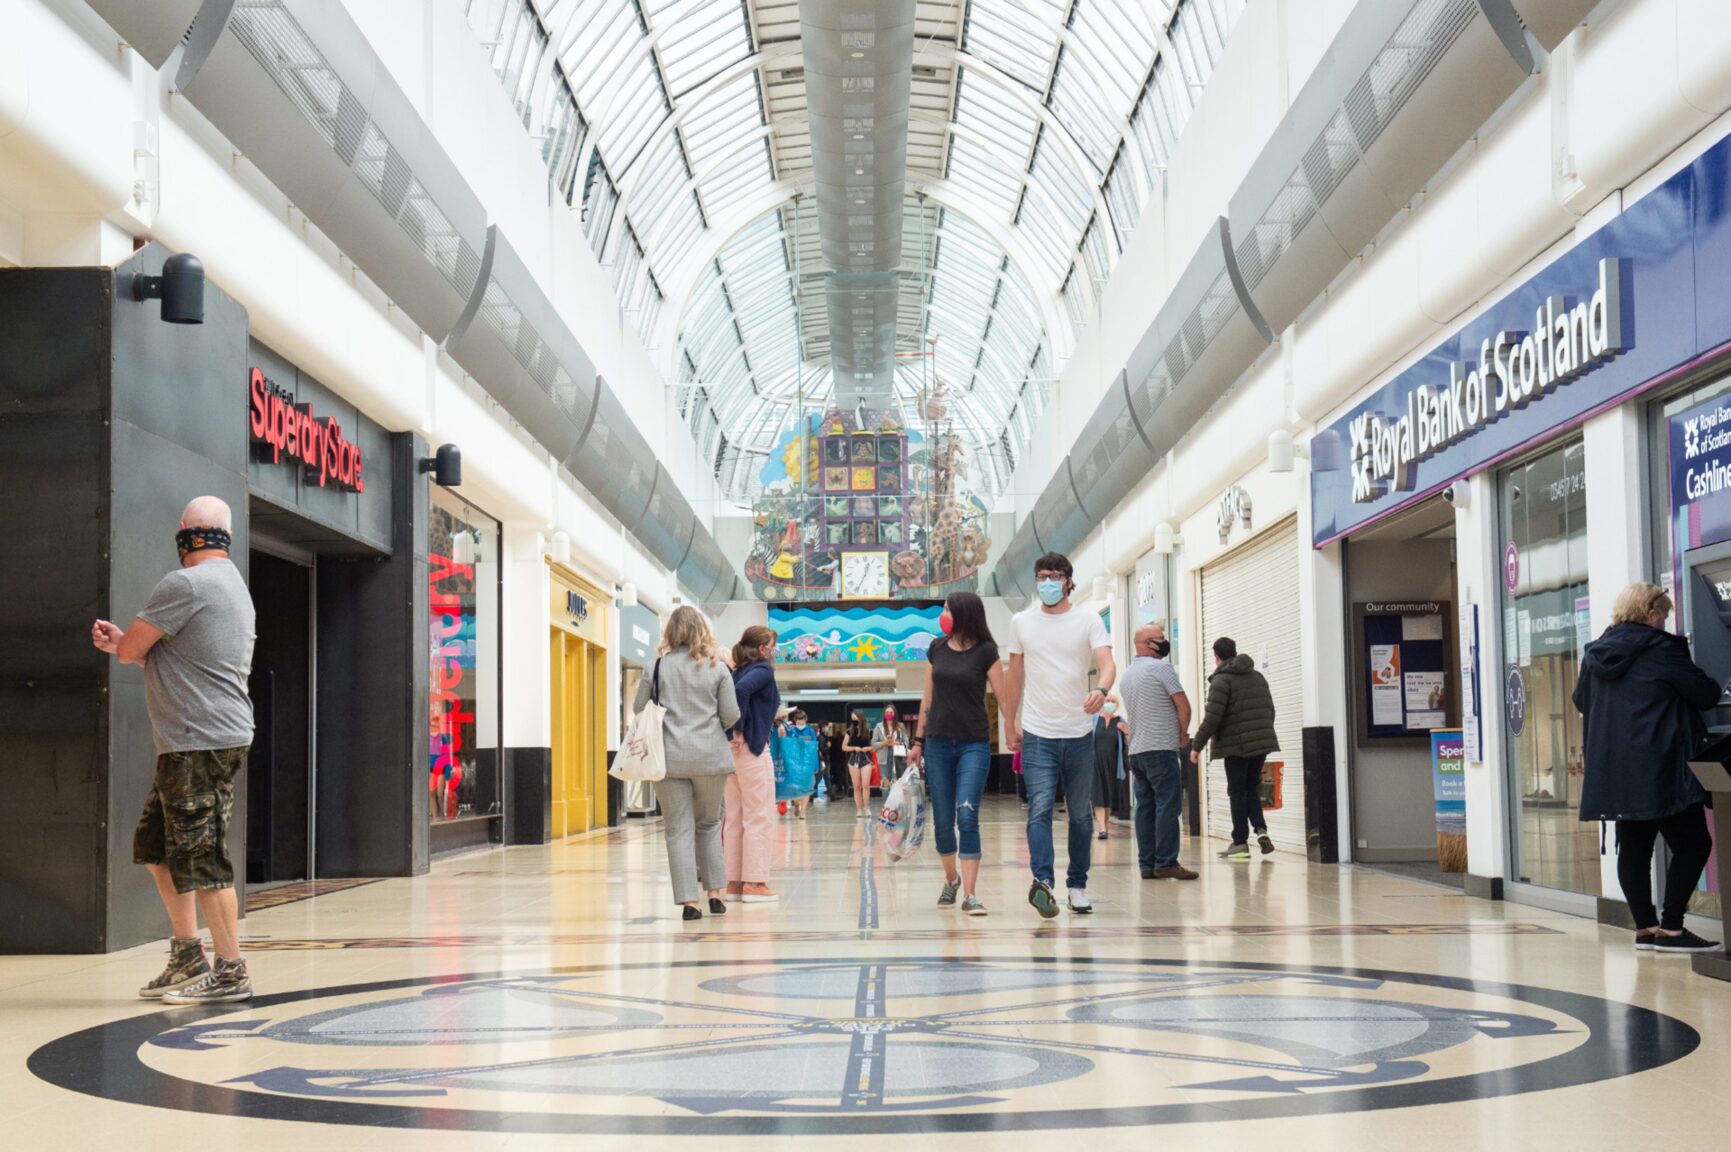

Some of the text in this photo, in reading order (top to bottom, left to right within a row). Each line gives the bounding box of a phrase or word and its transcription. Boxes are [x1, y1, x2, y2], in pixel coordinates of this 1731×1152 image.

[1372, 258, 1611, 492] Royal Bank of Scotland
[1701, 406, 1731, 433] Royal Ban
[1701, 429, 1731, 454] of Scotlan
[1686, 459, 1731, 500] Cashline
[1366, 602, 1440, 613] Our community
[1441, 760, 1461, 771] and
